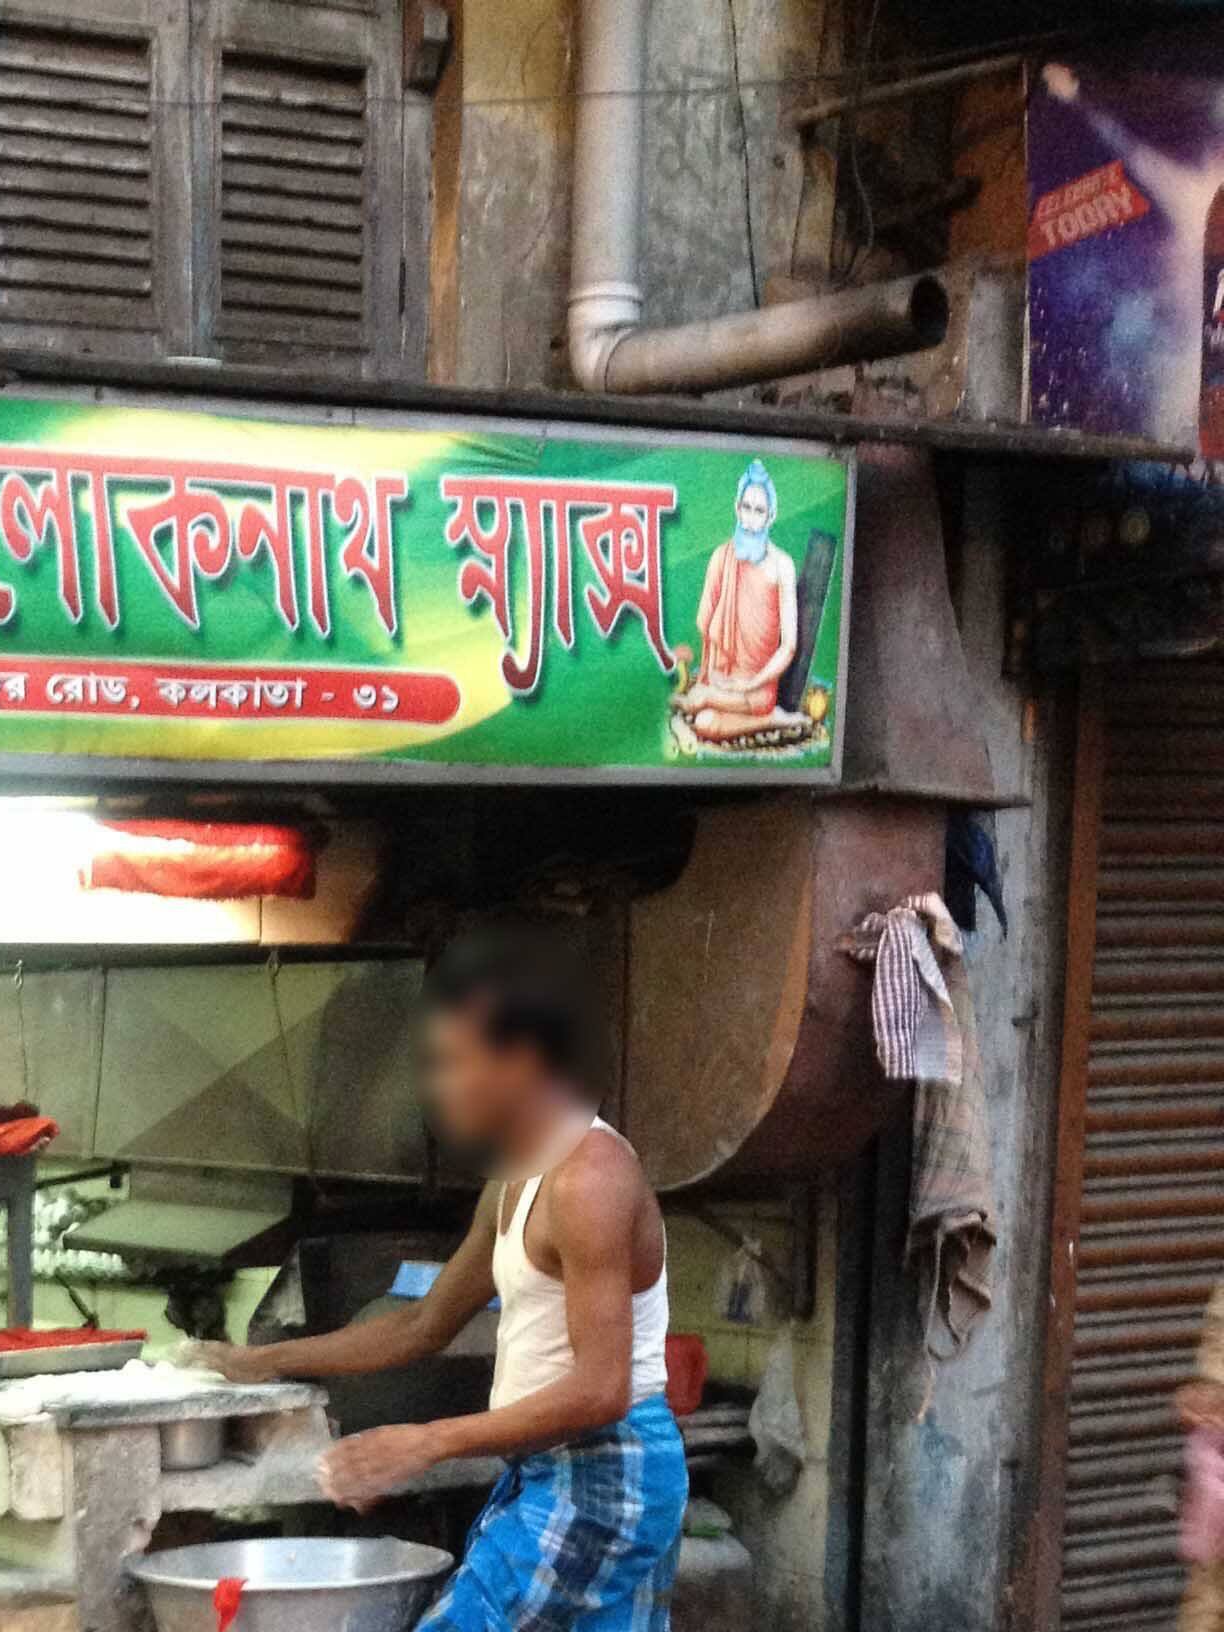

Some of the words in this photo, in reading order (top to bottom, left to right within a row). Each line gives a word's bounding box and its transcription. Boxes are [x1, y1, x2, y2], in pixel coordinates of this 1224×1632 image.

[1040, 183, 1133, 248] TODAY
[45, 672, 141, 710] রোড,
[155, 676, 308, 711] কলকাতা
[352, 684, 400, 714] ৩১
